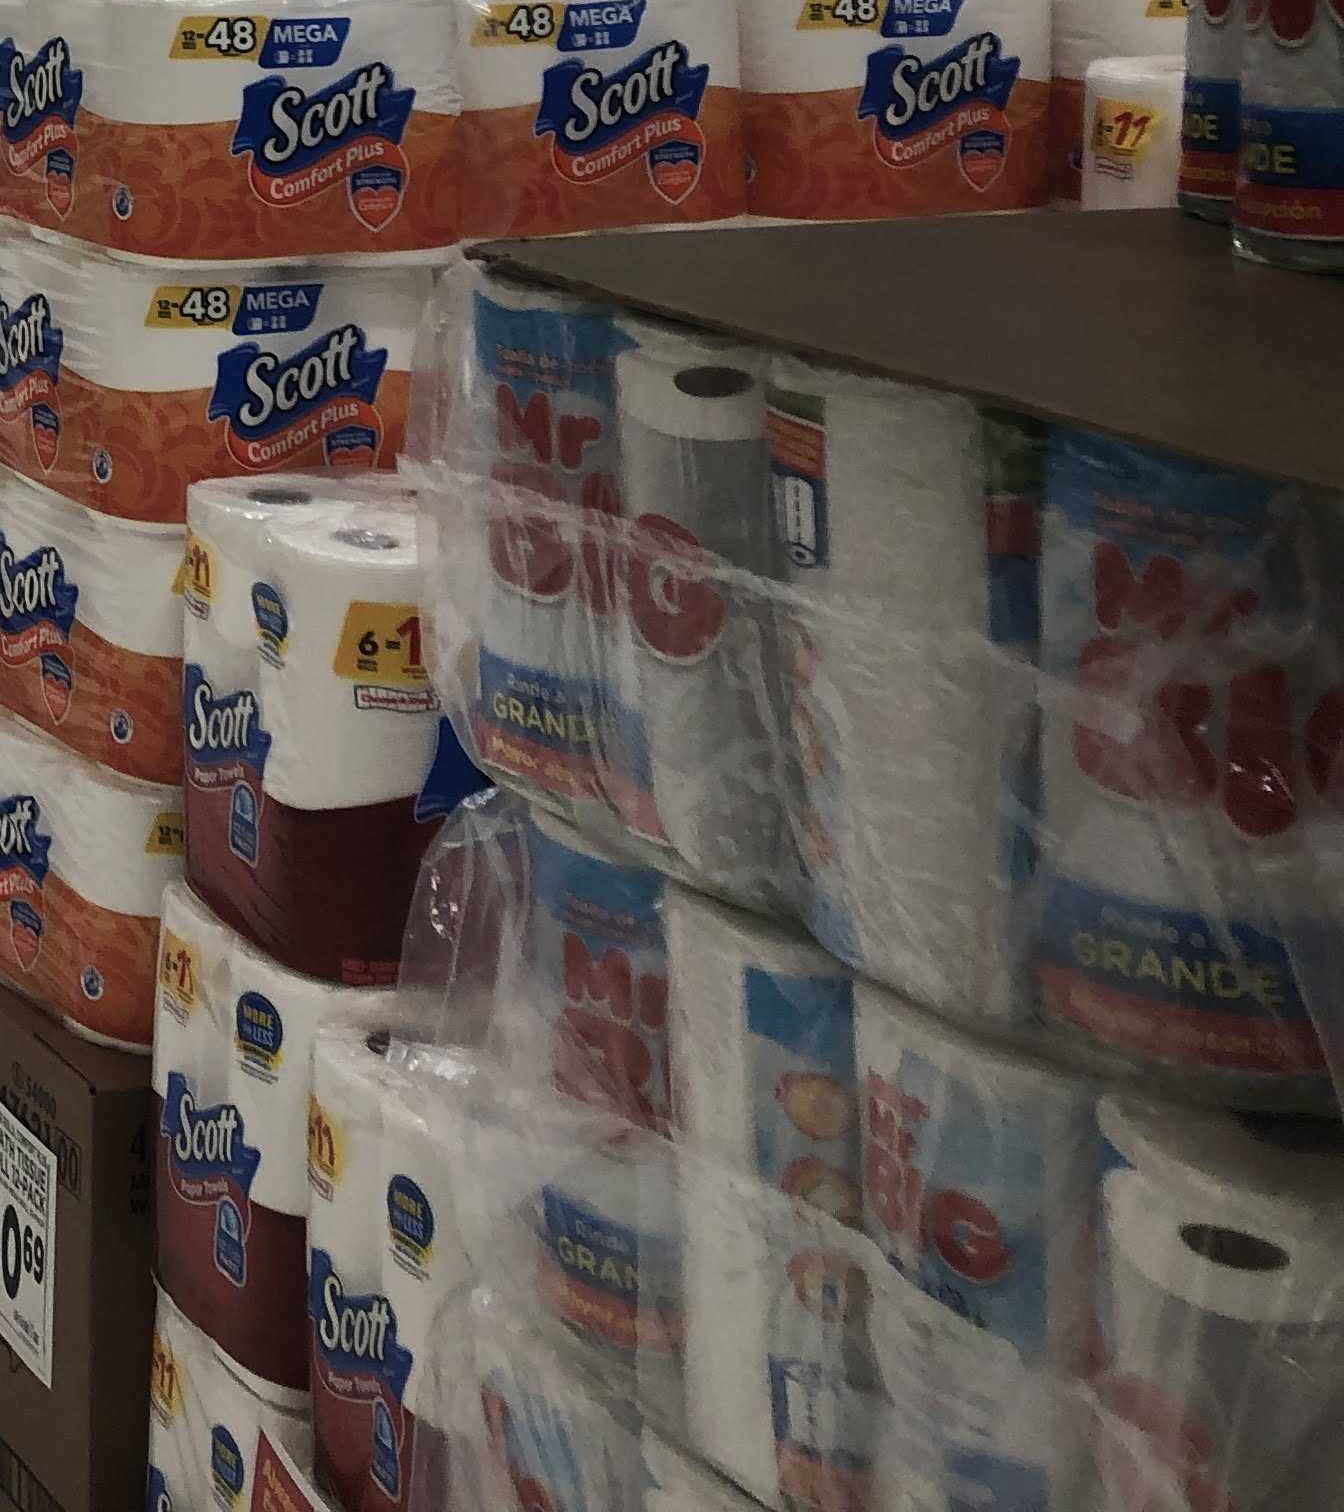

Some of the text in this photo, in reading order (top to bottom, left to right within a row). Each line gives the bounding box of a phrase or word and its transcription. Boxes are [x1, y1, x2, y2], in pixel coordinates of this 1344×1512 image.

[205, 19, 256, 52] 48
[273, 25, 339, 44] MEGA
[508, 6, 554, 37] 48
[569, 6, 634, 28] MEGA
[8, 39, 67, 128] Scott
[564, 41, 680, 142] Scott
[886, 32, 993, 126] Scott
[43, 123, 67, 147] Plus
[264, 64, 386, 163] Scott
[890, 106, 990, 163] Comfort Plus
[270, 139, 385, 199] Comfort Plus
[571, 117, 682, 178] Comfort Plus
[183, 290, 229, 321] 48
[246, 289, 310, 311] MEGA
[239, 325, 357, 427] Scott
[246, 402, 360, 463] Comfort Plus
[0, 549, 58, 619] Scott
[39, 626, 63, 647] Plus
[189, 684, 254, 750] Scott
[243, 1004, 274, 1029] MORE
[175, 1093, 237, 1163] Scott
[320, 1275, 390, 1361] Scott
